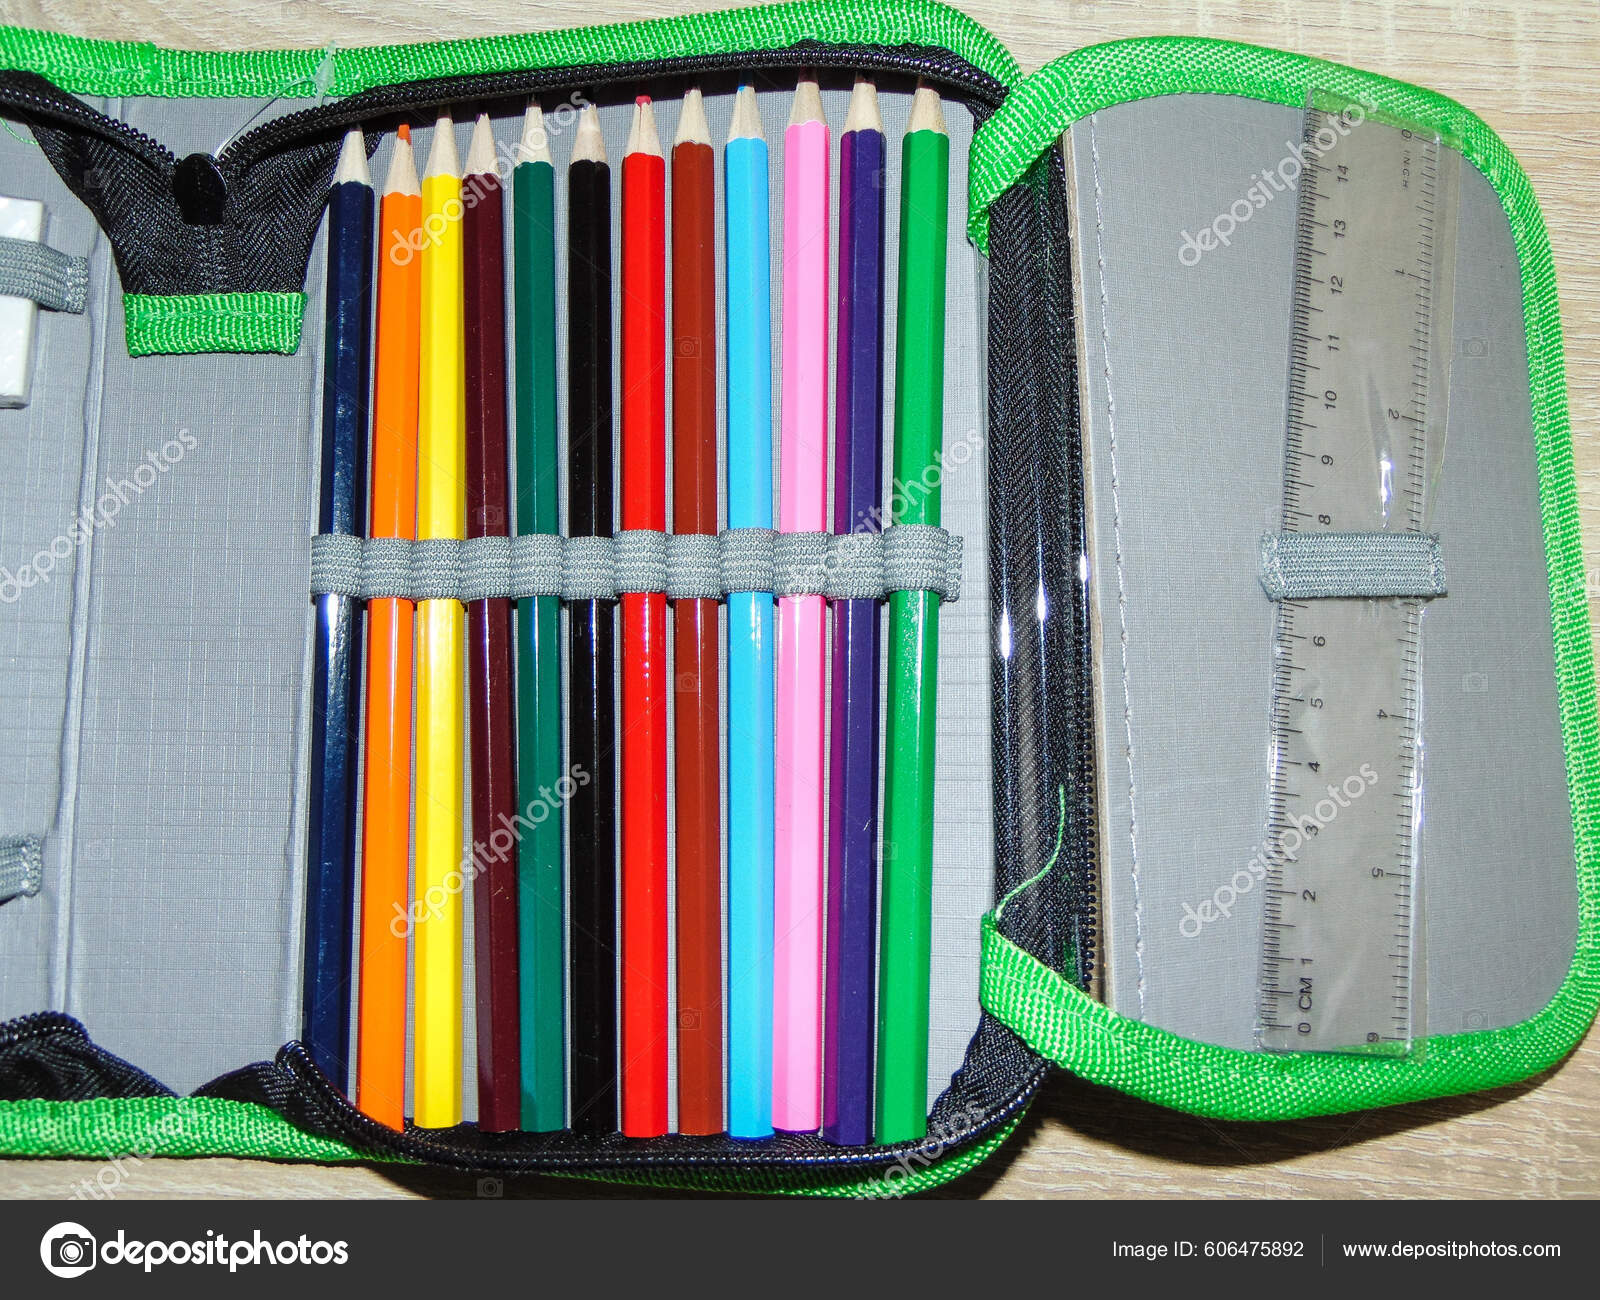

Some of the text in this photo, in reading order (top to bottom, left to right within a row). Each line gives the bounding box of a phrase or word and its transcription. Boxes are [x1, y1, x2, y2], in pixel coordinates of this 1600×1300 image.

[1337, 164, 1349, 183] 14
[1333, 219, 1346, 238] 13
[1330, 275, 1343, 295] 12
[1327, 334, 1340, 351] 11
[1324, 390, 1337, 410] 10
[1321, 454, 1334, 466] 9
[1318, 514, 1331, 525] 8
[1366, 129, 1413, 1042] 0 INCH 1 2 4 5 6
[1313, 635, 1326, 647] 6
[1311, 698, 1323, 709] 5
[1308, 761, 1320, 772] 4
[1305, 825, 1319, 836] 3
[1302, 889, 1316, 902] 2
[1301, 957, 1314, 966] 1
[1299, 977, 1313, 1011] CM
[1298, 1022, 1312, 1034] 0
